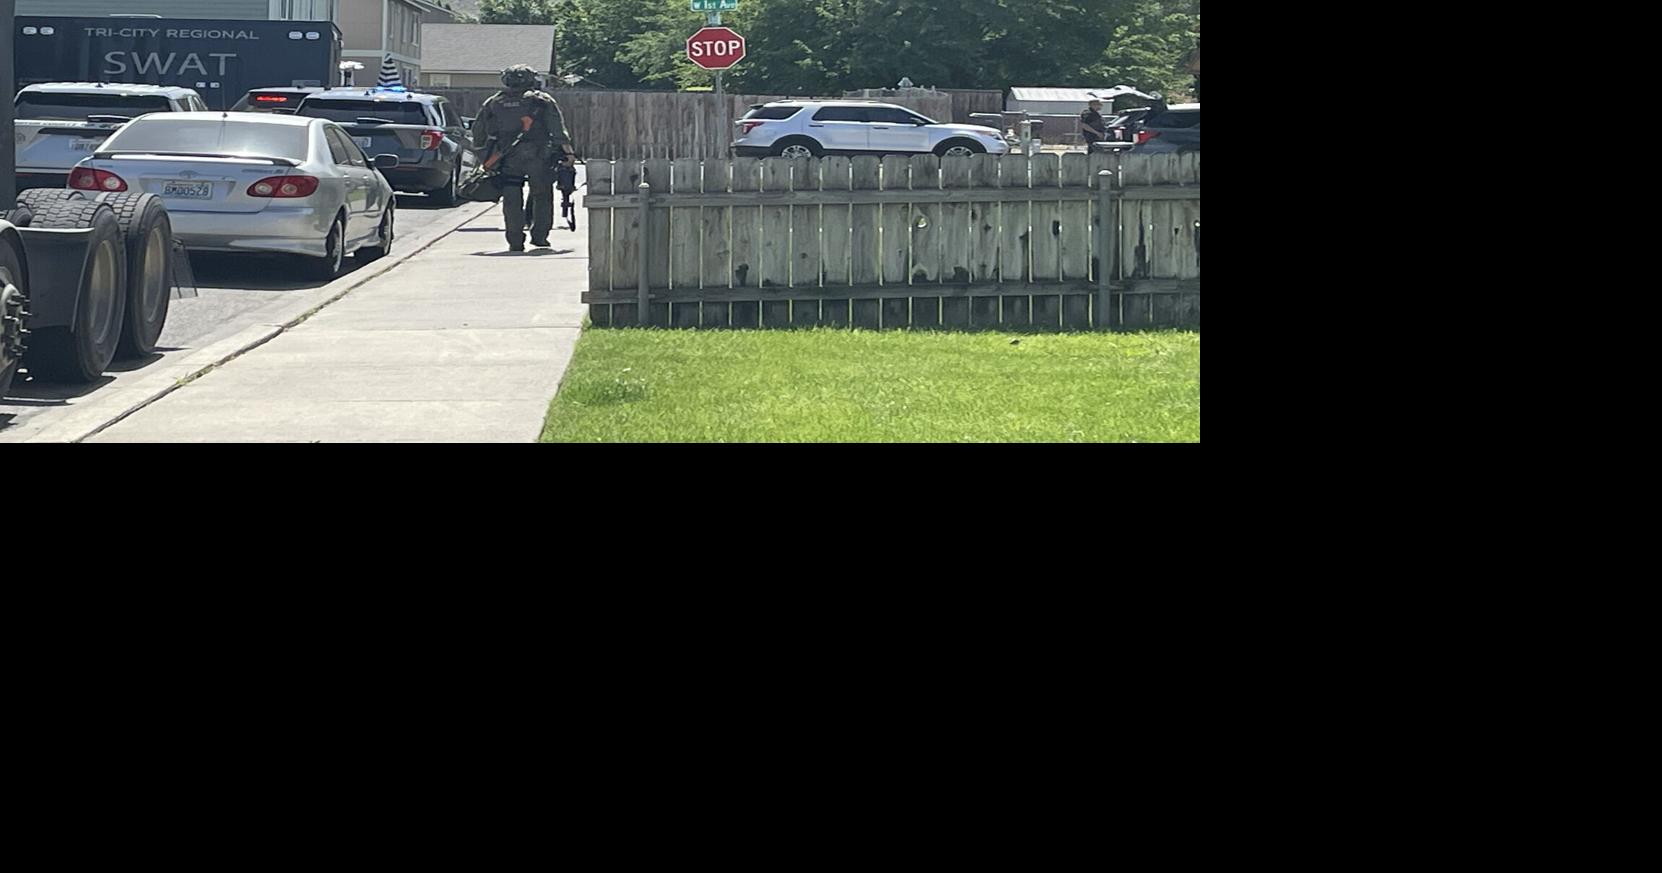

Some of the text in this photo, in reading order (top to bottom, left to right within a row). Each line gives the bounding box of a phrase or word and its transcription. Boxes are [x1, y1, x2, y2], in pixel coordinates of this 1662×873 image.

[703, 0, 716, 9] 1st
[84, 27, 260, 40] TRI-CITY REGIONAL
[691, 40, 741, 57] STOP
[103, 51, 237, 76] SWAT
